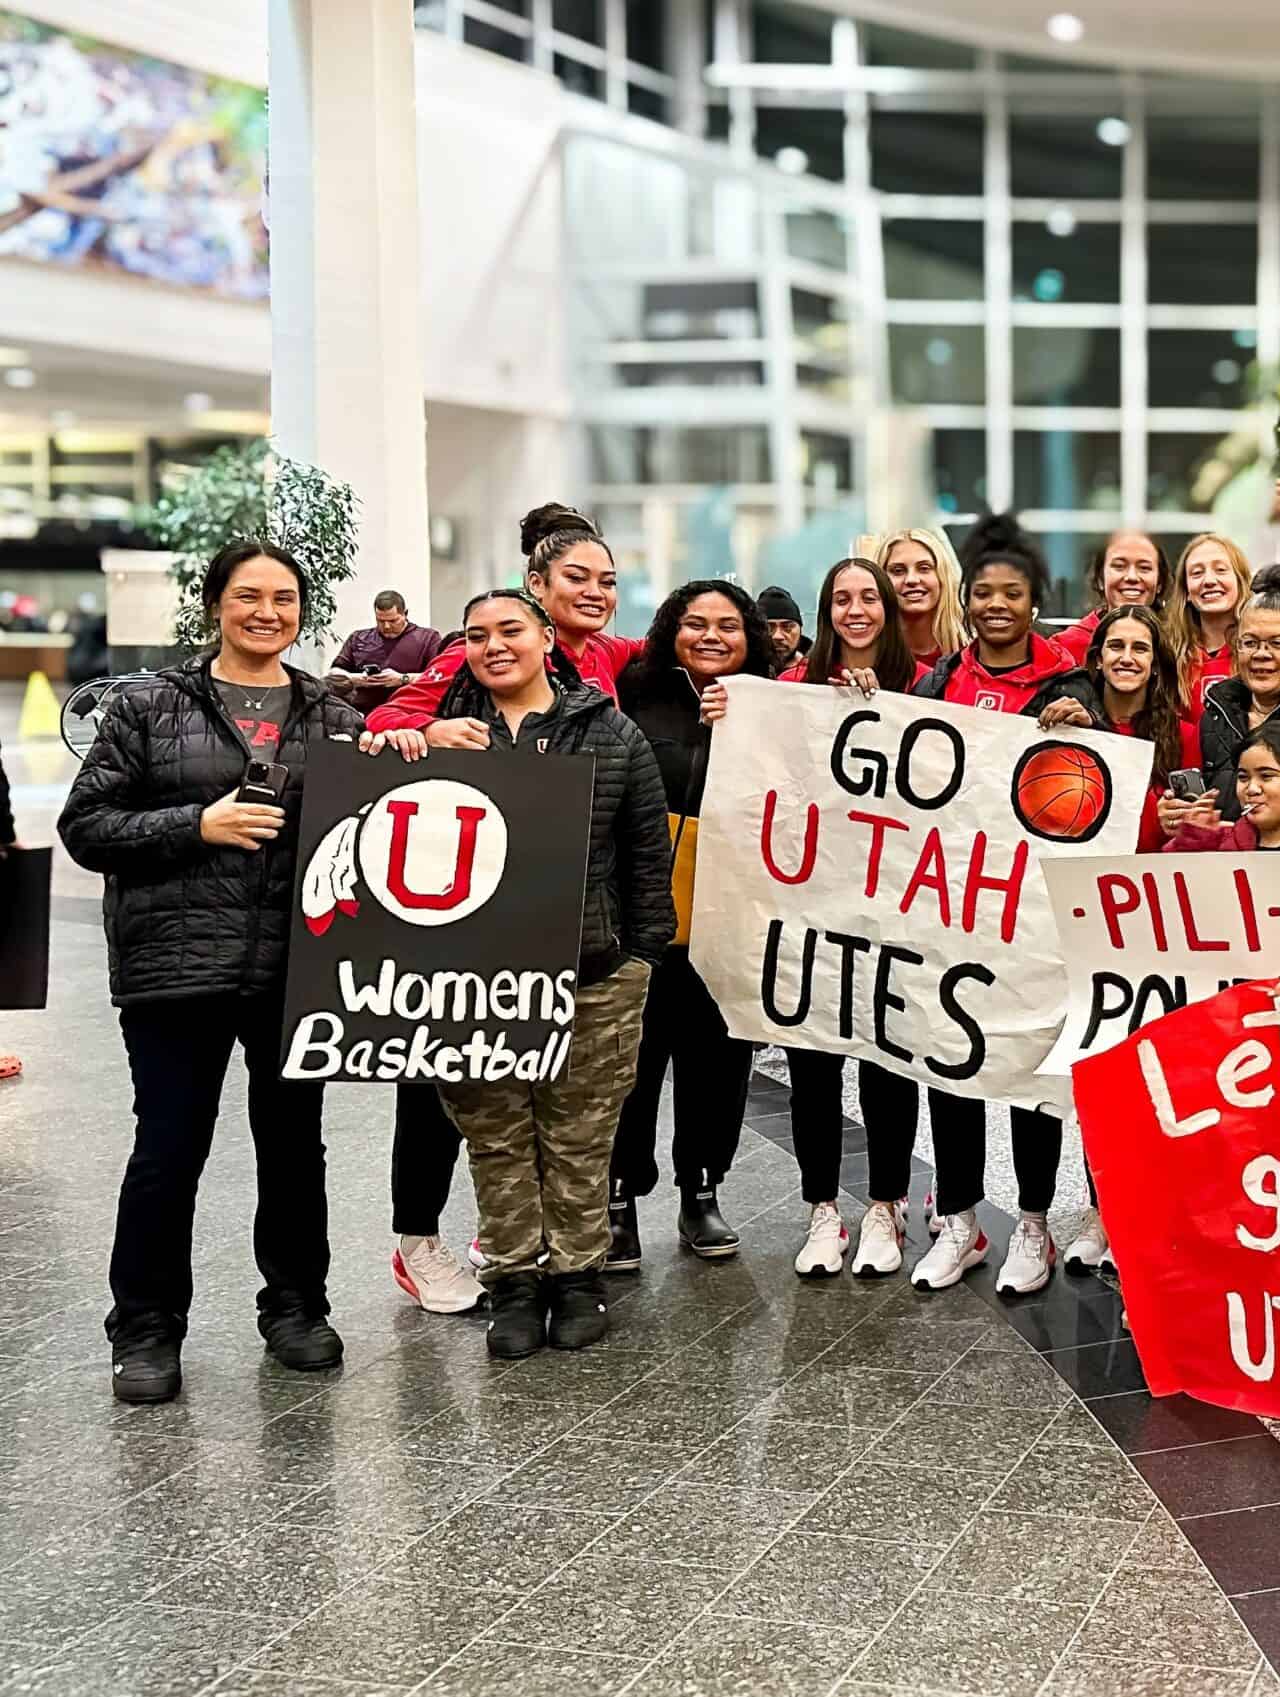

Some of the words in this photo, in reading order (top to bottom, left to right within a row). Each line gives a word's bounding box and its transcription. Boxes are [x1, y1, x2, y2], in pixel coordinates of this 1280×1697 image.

[830, 710, 965, 810] GO
[387, 800, 486, 910] U
[761, 790, 1029, 944] UTAH
[338, 959, 577, 1026] Womens
[761, 919, 997, 1080] UTES
[281, 1012, 573, 1083] Basketball
